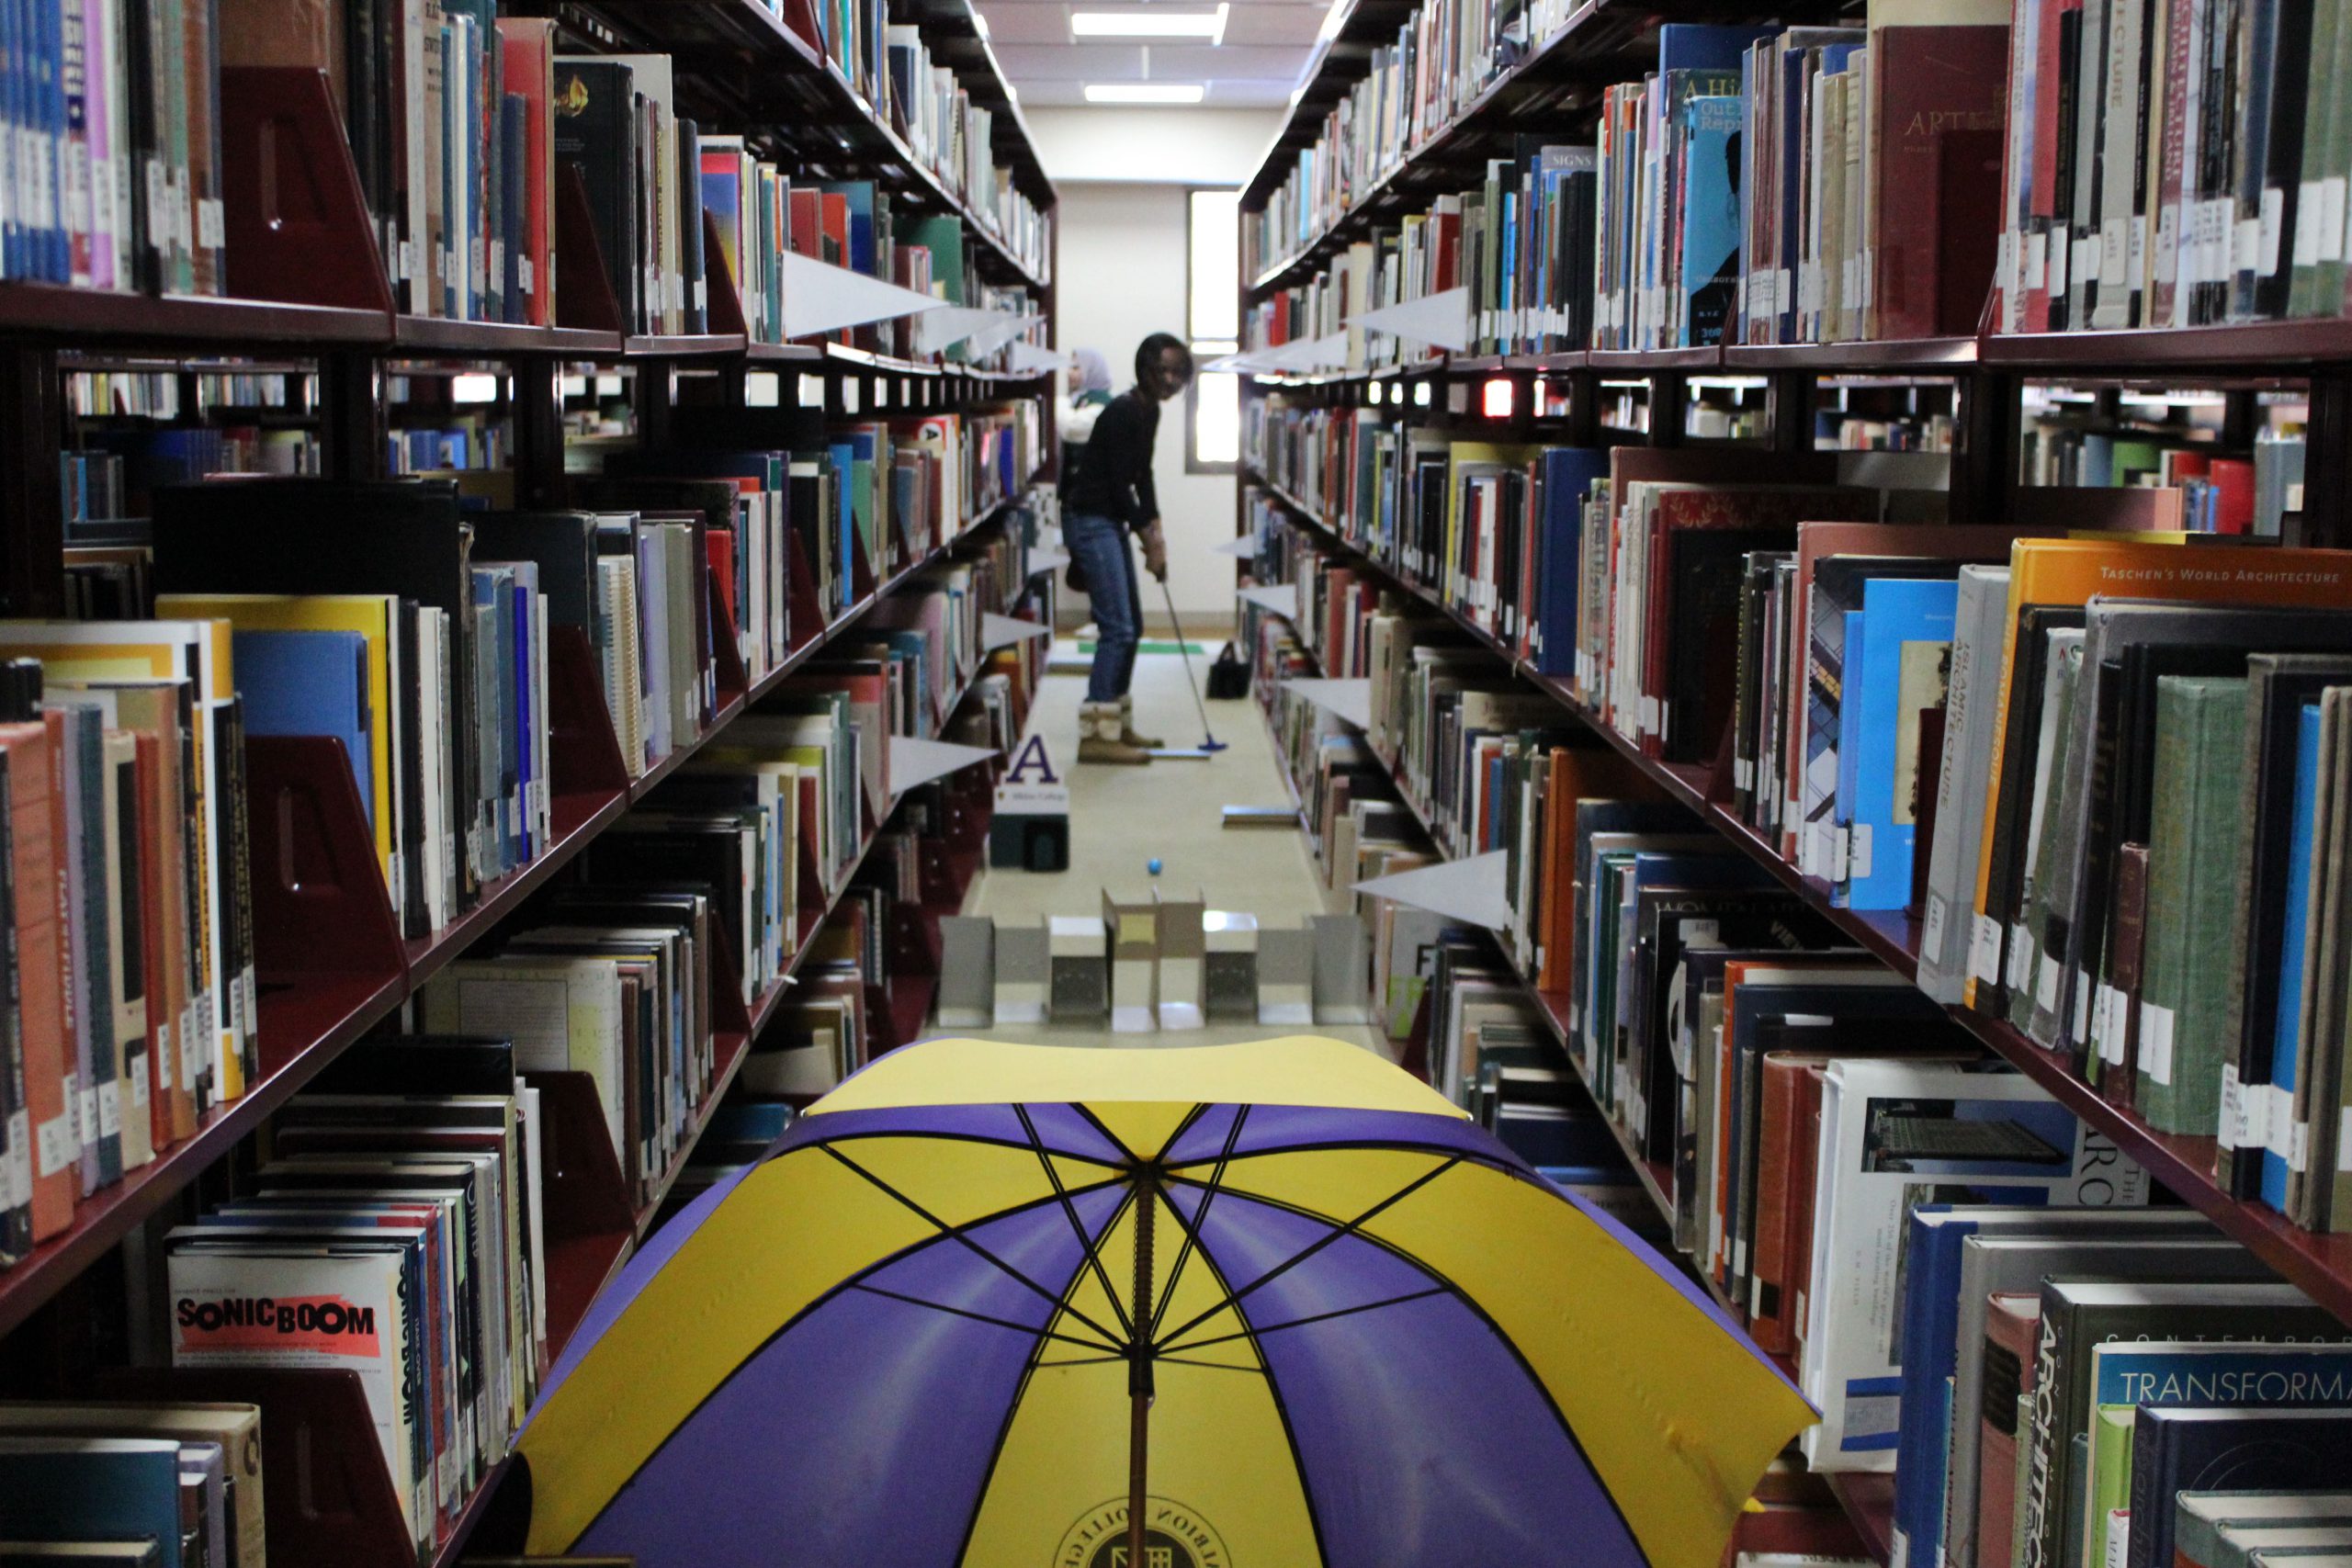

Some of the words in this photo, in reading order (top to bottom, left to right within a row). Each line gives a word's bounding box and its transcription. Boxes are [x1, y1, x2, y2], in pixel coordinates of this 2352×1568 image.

[1553, 154, 1592, 166] SIGNS
[2099, 566, 2174, 581] TASCHEN'S
[2180, 569, 2231, 581] WORLD
[2235, 569, 2340, 583] ARCHITECTURE
[1957, 642, 1972, 734] ISLAMIC
[1939, 637, 1963, 810] ARCHITECTURE
[1990, 654, 2009, 788] ROMANESQUE
[1005, 734, 1059, 784] A
[2120, 1371, 2352, 1403] TRANSFORM
